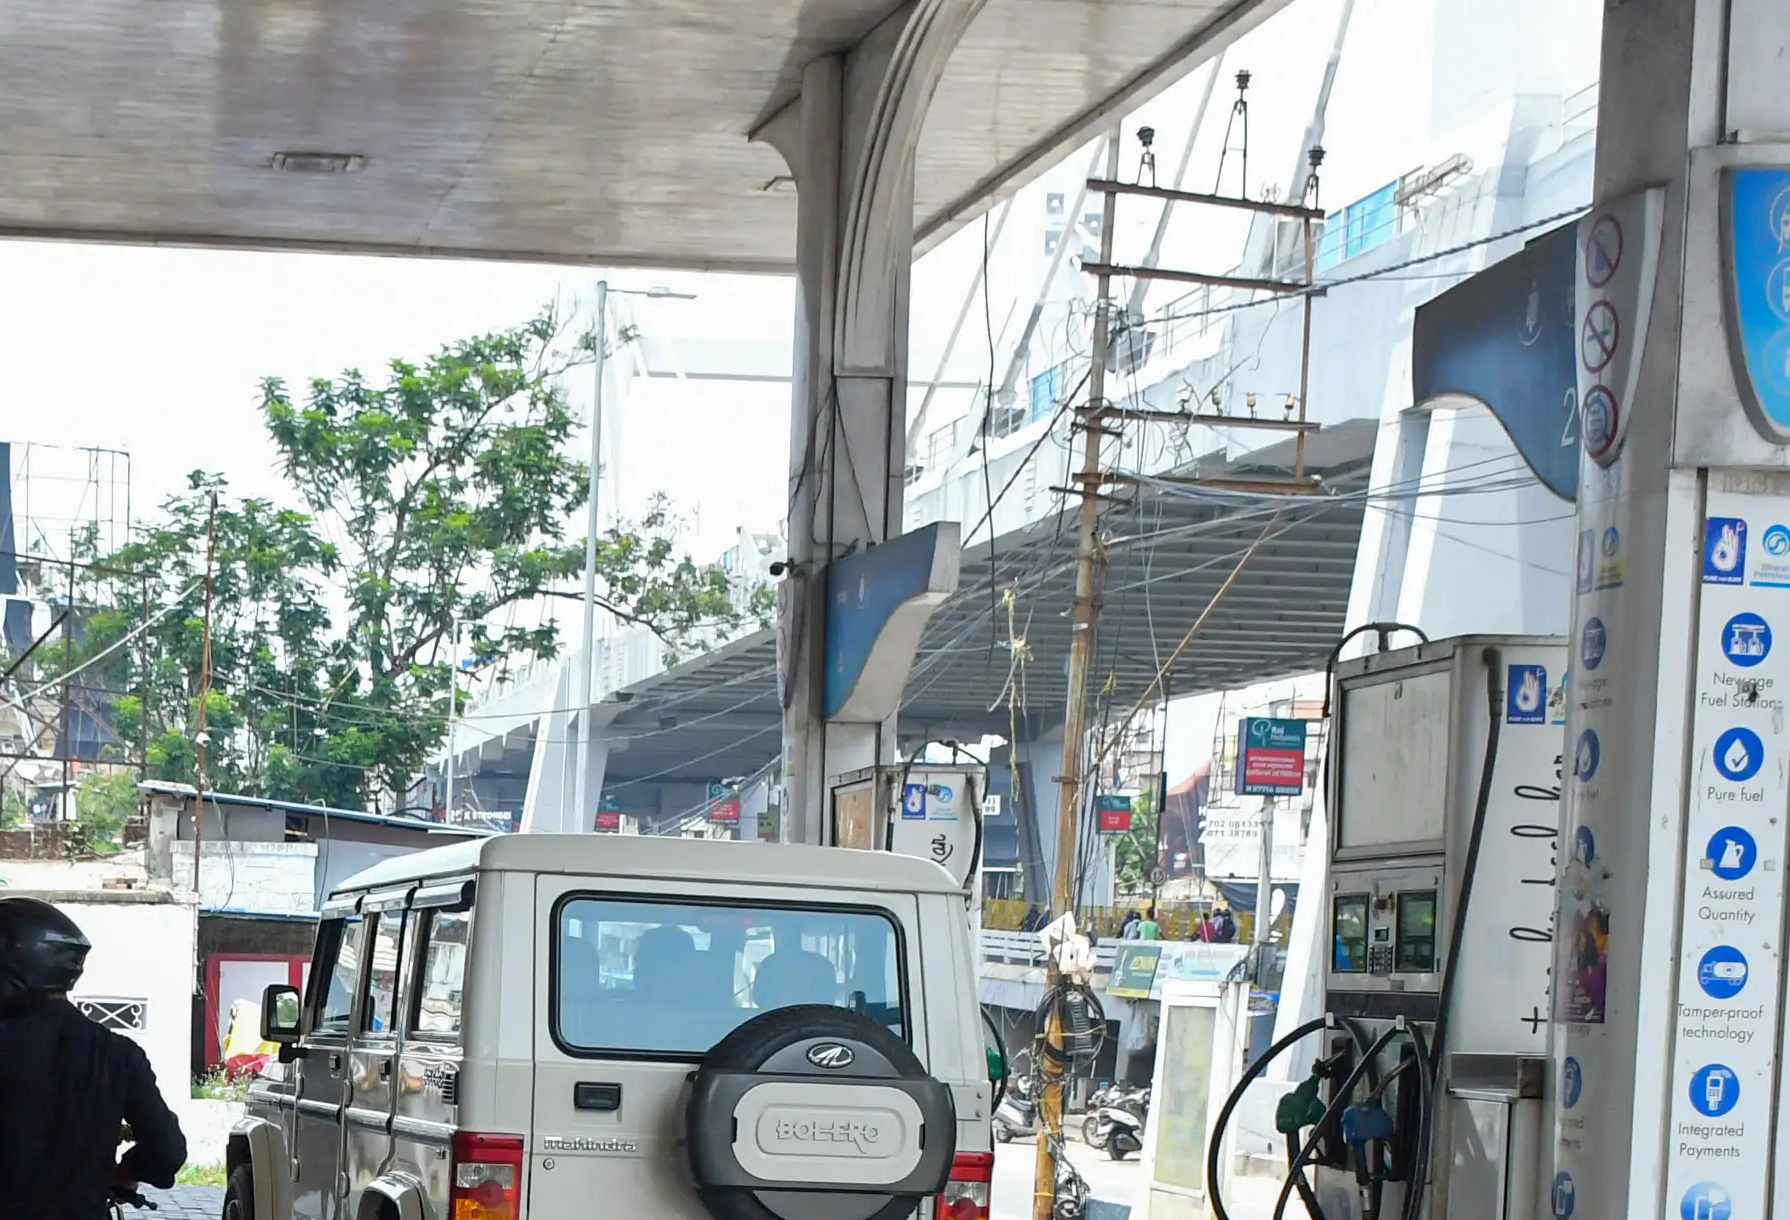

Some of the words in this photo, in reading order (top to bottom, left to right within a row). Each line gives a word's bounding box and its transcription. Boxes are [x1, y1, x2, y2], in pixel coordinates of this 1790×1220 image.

[1561, 387, 1577, 448] 2
[1701, 692, 1727, 706] Fuel
[1707, 786, 1736, 801] Pure
[1740, 786, 1765, 802] fuel
[1701, 886, 1755, 901] Assured
[1698, 906, 1756, 925] Quantity
[1678, 1003, 1764, 1022] Tamper-proof
[1682, 1025, 1755, 1044] technology
[775, 1119, 879, 1154] BOLERO
[1677, 1122, 1744, 1139] Integrated
[1678, 1142, 1741, 1160] Payments
